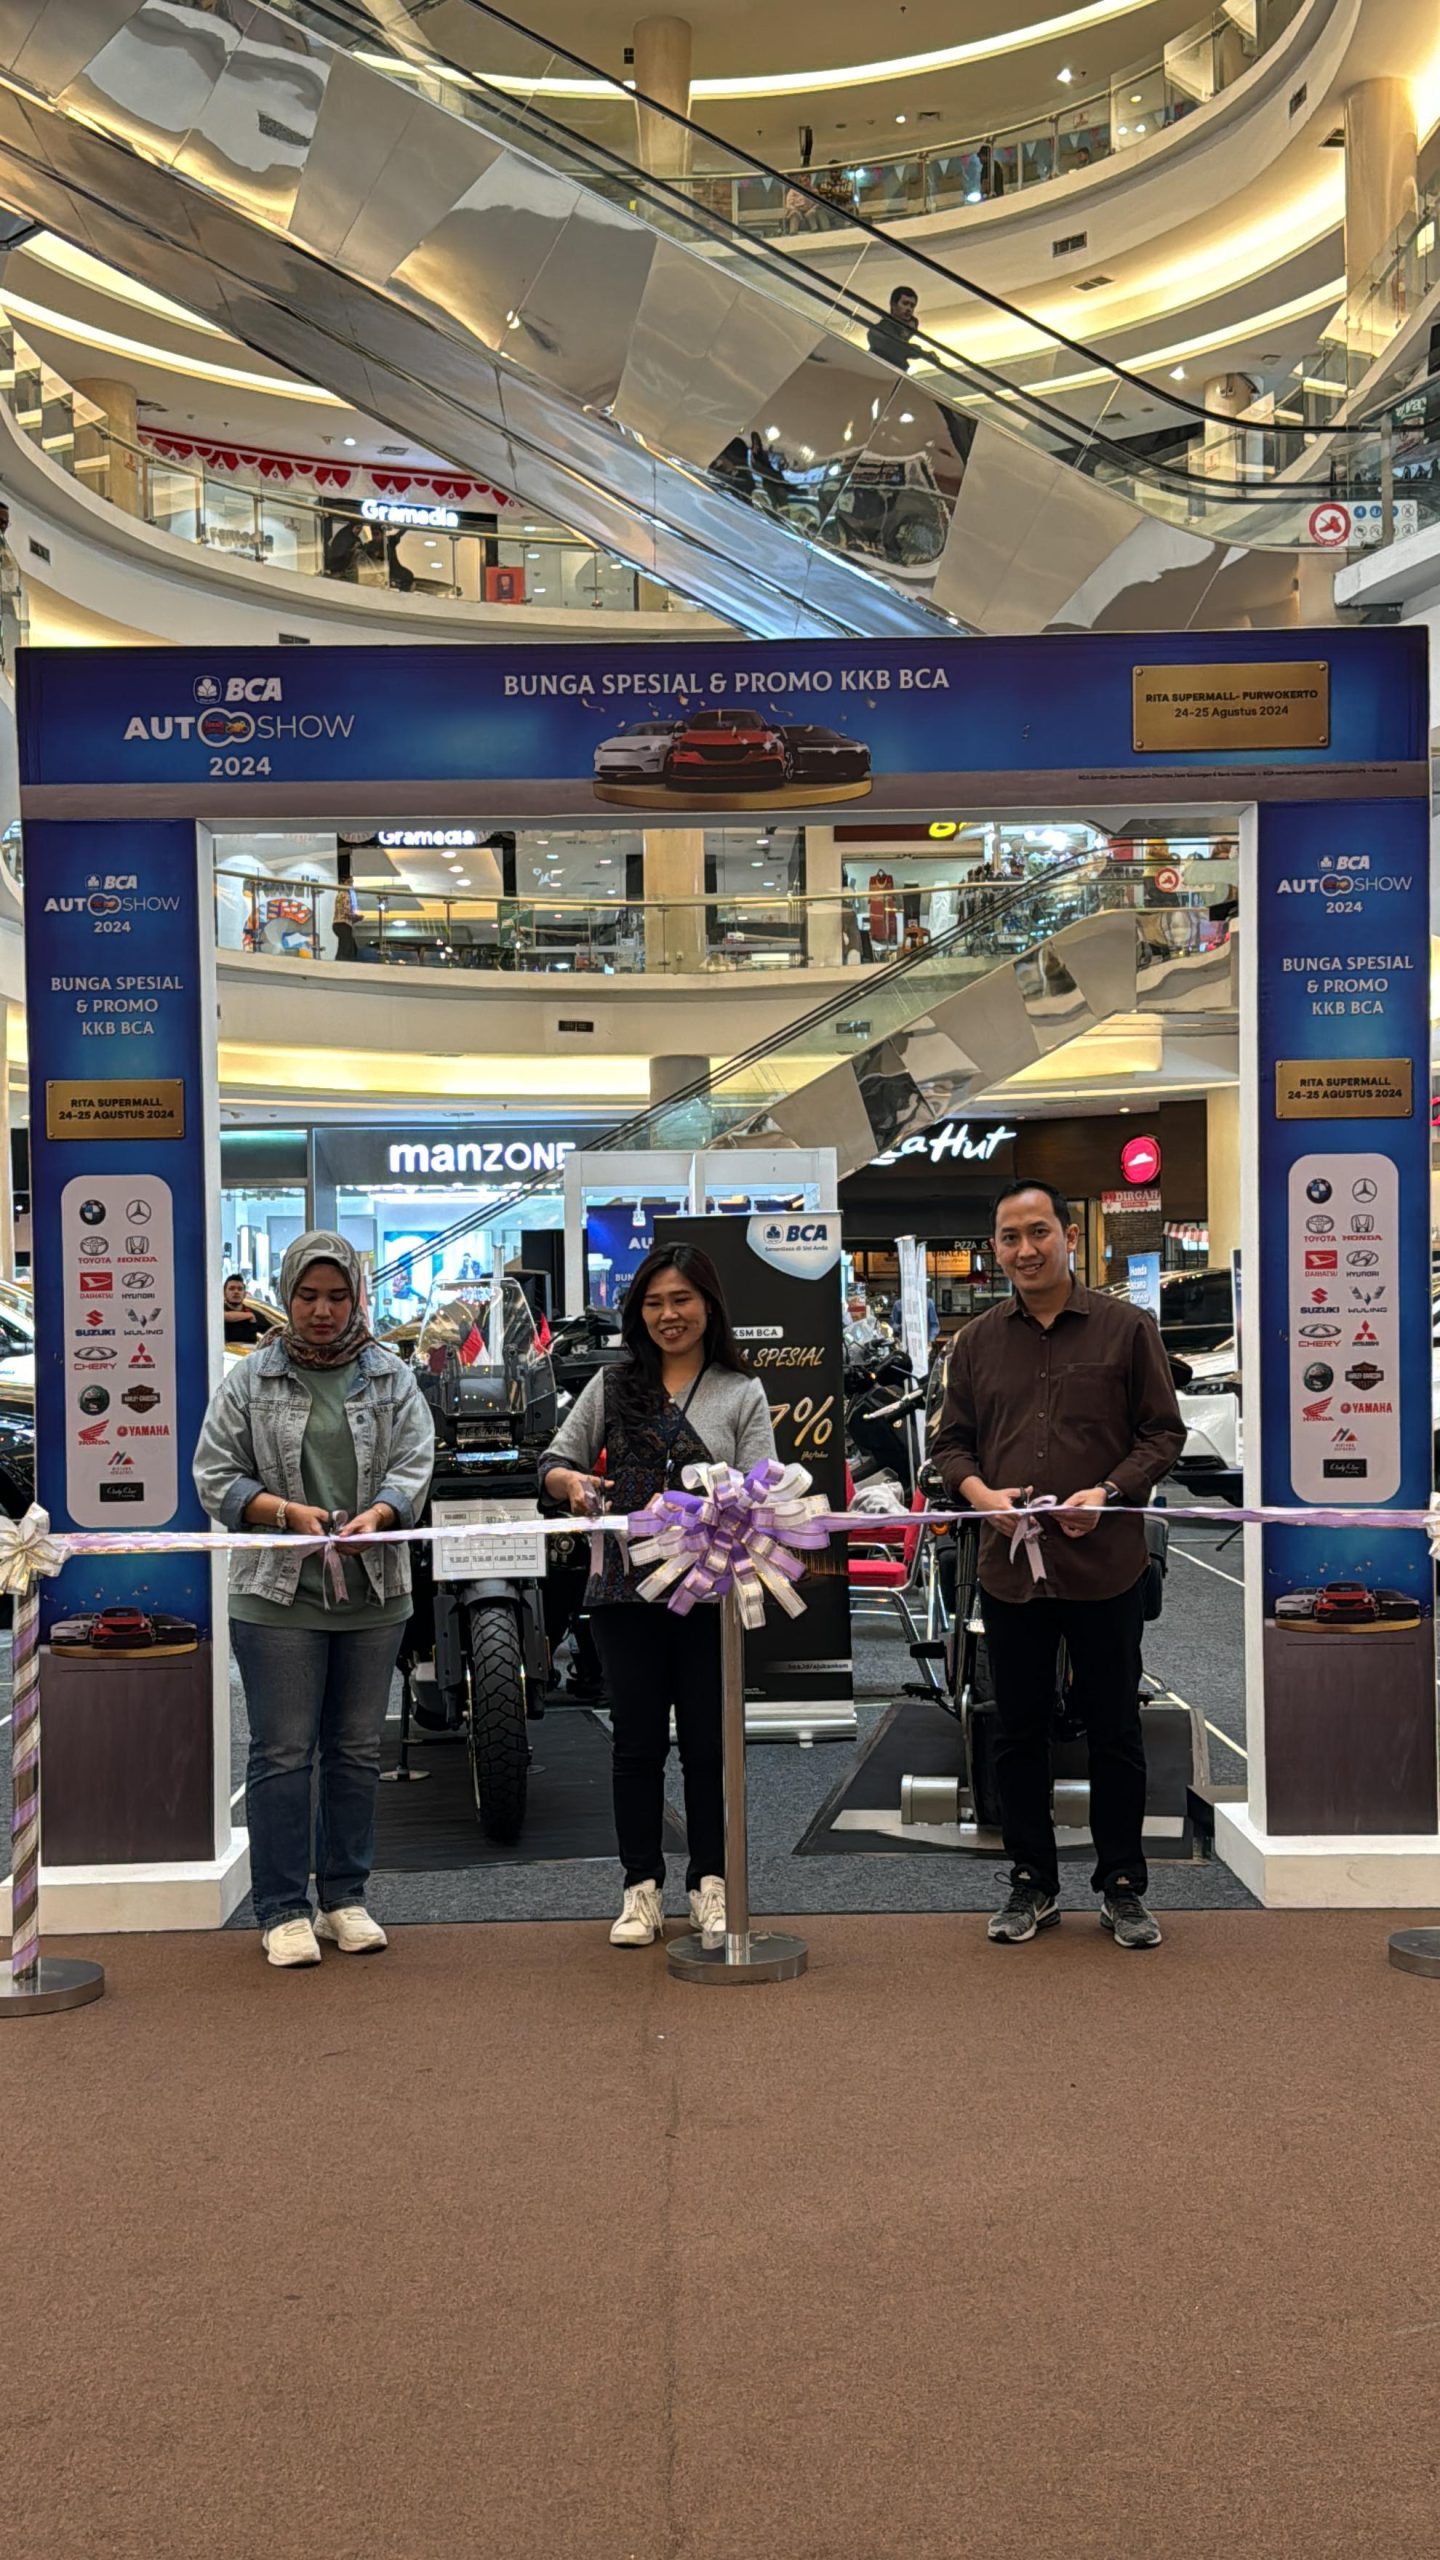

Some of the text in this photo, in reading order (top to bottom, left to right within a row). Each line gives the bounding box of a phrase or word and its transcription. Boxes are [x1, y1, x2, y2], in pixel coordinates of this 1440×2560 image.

[361, 499, 459, 528] Gramedia
[225, 677, 281, 701] BCA
[504, 668, 950, 696] BUNGA SPESIAL & PROMO KKB BCA
[1146, 692, 1168, 703] RITA
[1242, 688, 1319, 700] PURWOKERTO
[1174, 704, 1289, 719] 24-25 Agustus 2024
[209, 757, 272, 776] 2024
[1337, 855, 1370, 870] BCA
[103, 875, 138, 890] BCA
[1326, 902, 1363, 913] 2024
[94, 921, 131, 933] 2024
[1283, 956, 1413, 972] BUNGA SPESIAL
[51, 976, 183, 991] BUNGA SPESIAL
[1307, 978, 1388, 993] & PROMO
[77, 999, 158, 1013] & PROMO
[1312, 1000, 1384, 1015] KKB BCA
[82, 1022, 154, 1035] KKB BCA
[1300, 1077, 1391, 1087] RITA SUPERMALL
[1288, 1089, 1402, 1100] 24-25 AGUSTUS 2024
[71, 1098, 162, 1107] RITA SUPERMALL
[59, 1110, 174, 1120] 24-25 AGUSTUS 2024
[927, 1122, 1017, 1163] Hut
[1115, 1189, 1161, 1201] DIRGAH
[786, 1224, 827, 1242] BCA
[628, 1237, 654, 1249] AU
[954, 1241, 977, 1249] PIZZA
[615, 1273, 635, 1281] BUN
[757, 1328, 778, 1337] BCA
[754, 1346, 825, 1367] SPESIAL
[74, 1363, 117, 1371] CHERY
[1352, 1402, 1392, 1414] YAMAHA
[129, 1425, 170, 1436] YAMAHA
